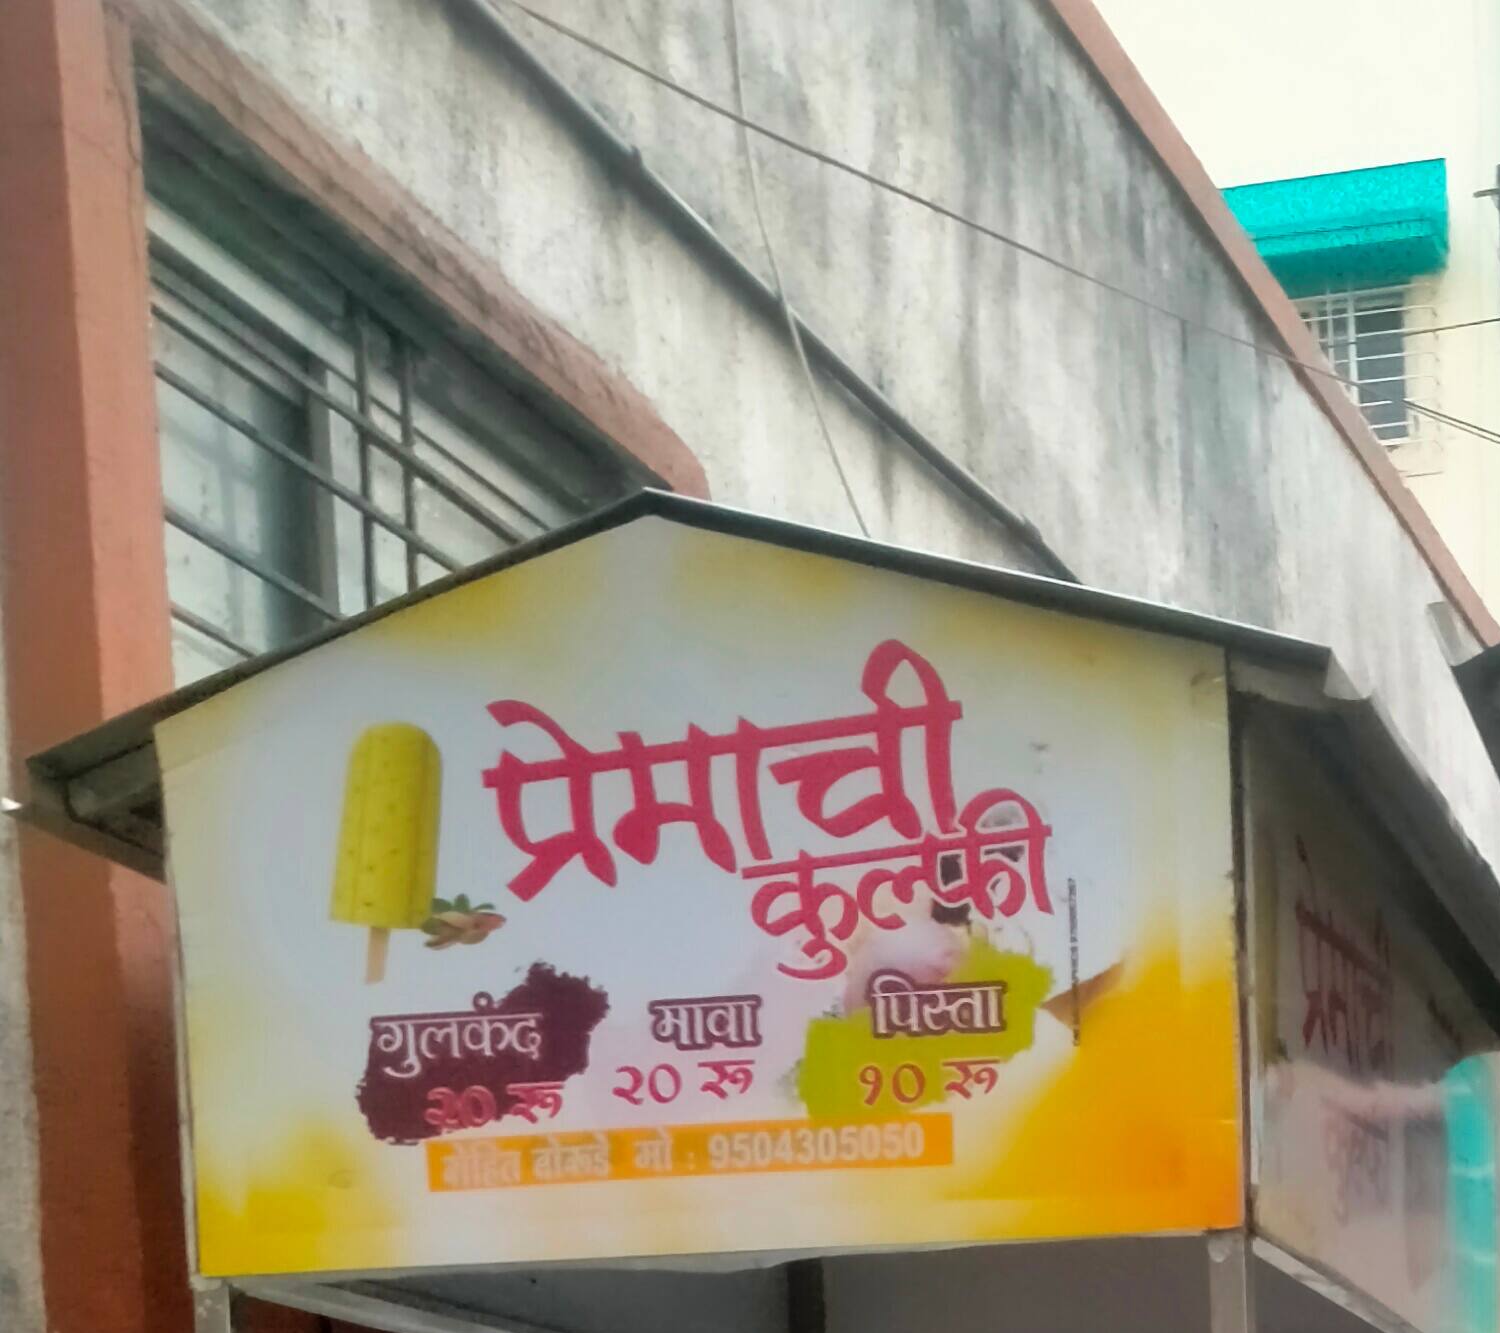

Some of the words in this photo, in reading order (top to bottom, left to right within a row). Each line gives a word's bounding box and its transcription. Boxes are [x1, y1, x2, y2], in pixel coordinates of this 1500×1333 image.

[483, 641, 961, 901] प्रेमाची
[742, 790, 1053, 980] कुल्फी
[650, 998, 760, 1048] मावा
[871, 976, 1006, 1033] पिस्ता
[372, 992, 542, 1077] गुलकंद
[506, 1081, 564, 1124] रू
[613, 1064, 680, 1105] २०
[699, 1060, 755, 1099] रू
[943, 1059, 998, 1098] रू
[708, 1123, 925, 1170] 9504305050
